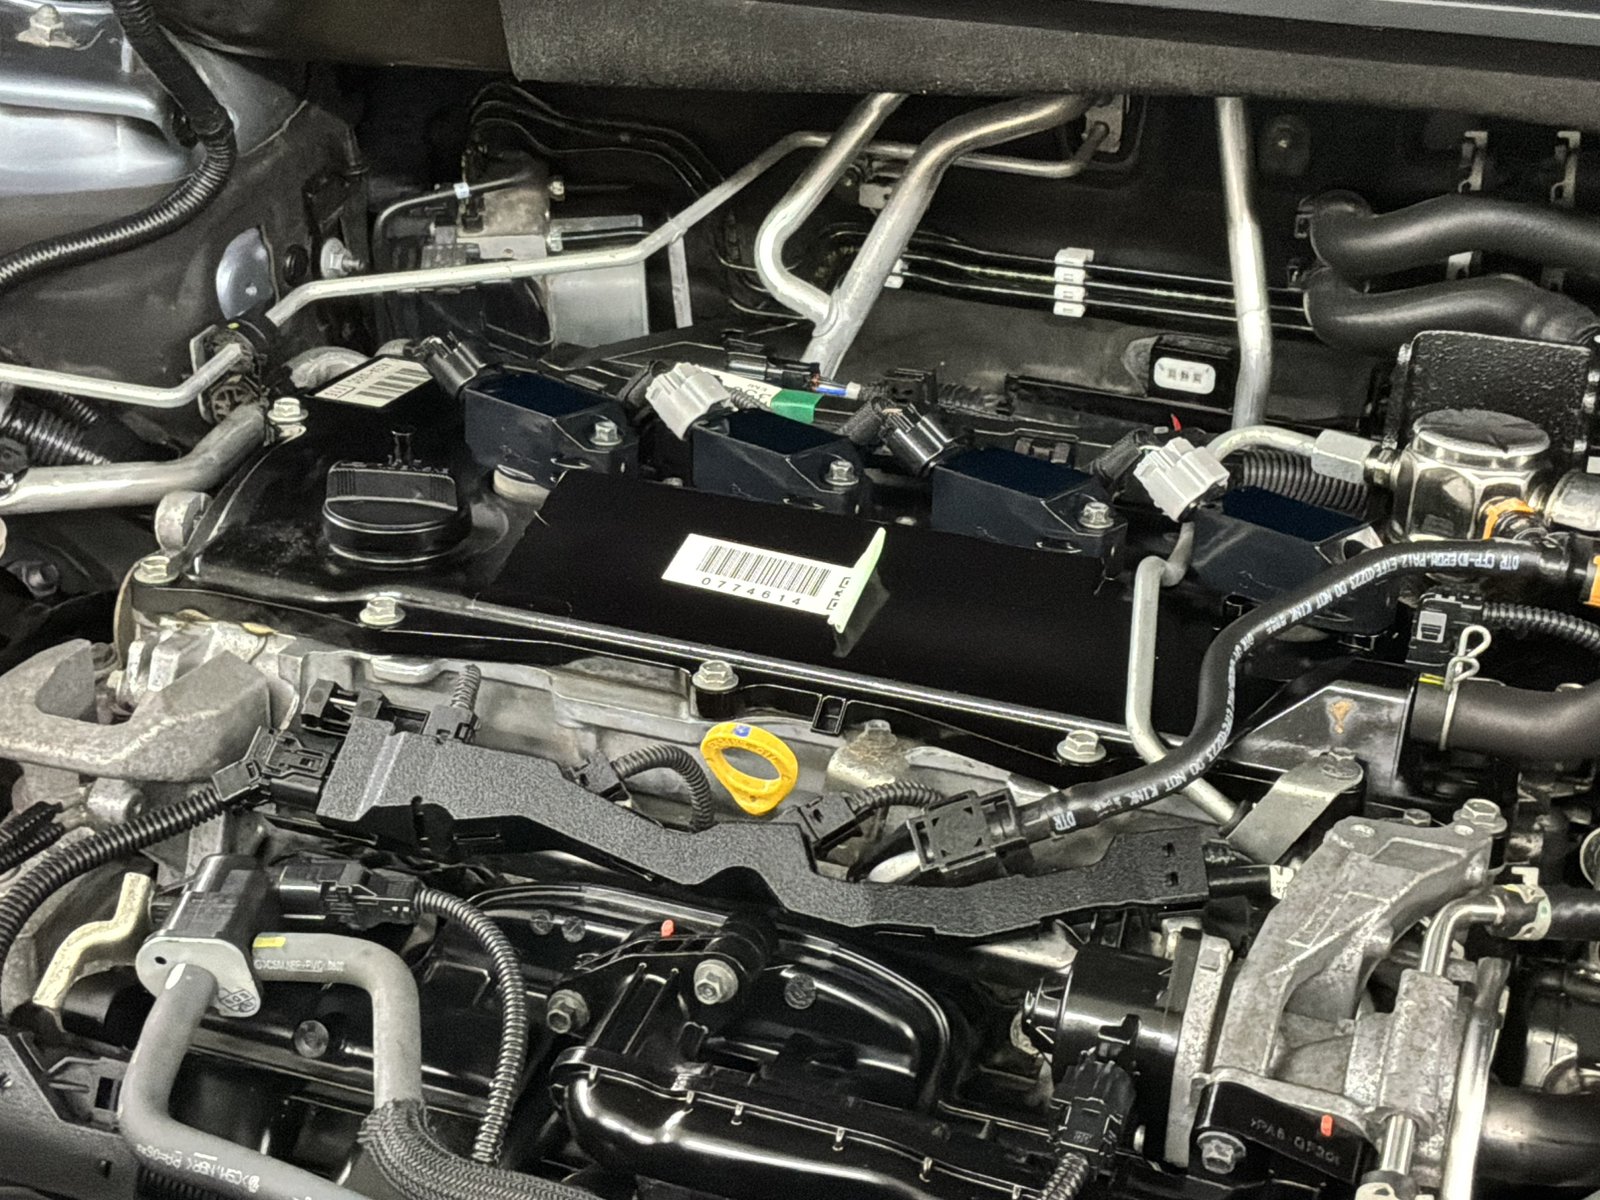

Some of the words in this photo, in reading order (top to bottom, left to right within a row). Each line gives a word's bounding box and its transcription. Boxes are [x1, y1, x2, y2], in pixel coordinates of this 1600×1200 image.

[701, 577, 801, 605] 0774614
[1316, 589, 1333, 609] NOT
[1334, 581, 1347, 598] DO
[1288, 600, 1312, 622] KINK
[1189, 759, 1205, 775] DO
[1164, 770, 1187, 792] NOT
[1124, 783, 1159, 806] KINK
[1052, 810, 1077, 831] DTR
